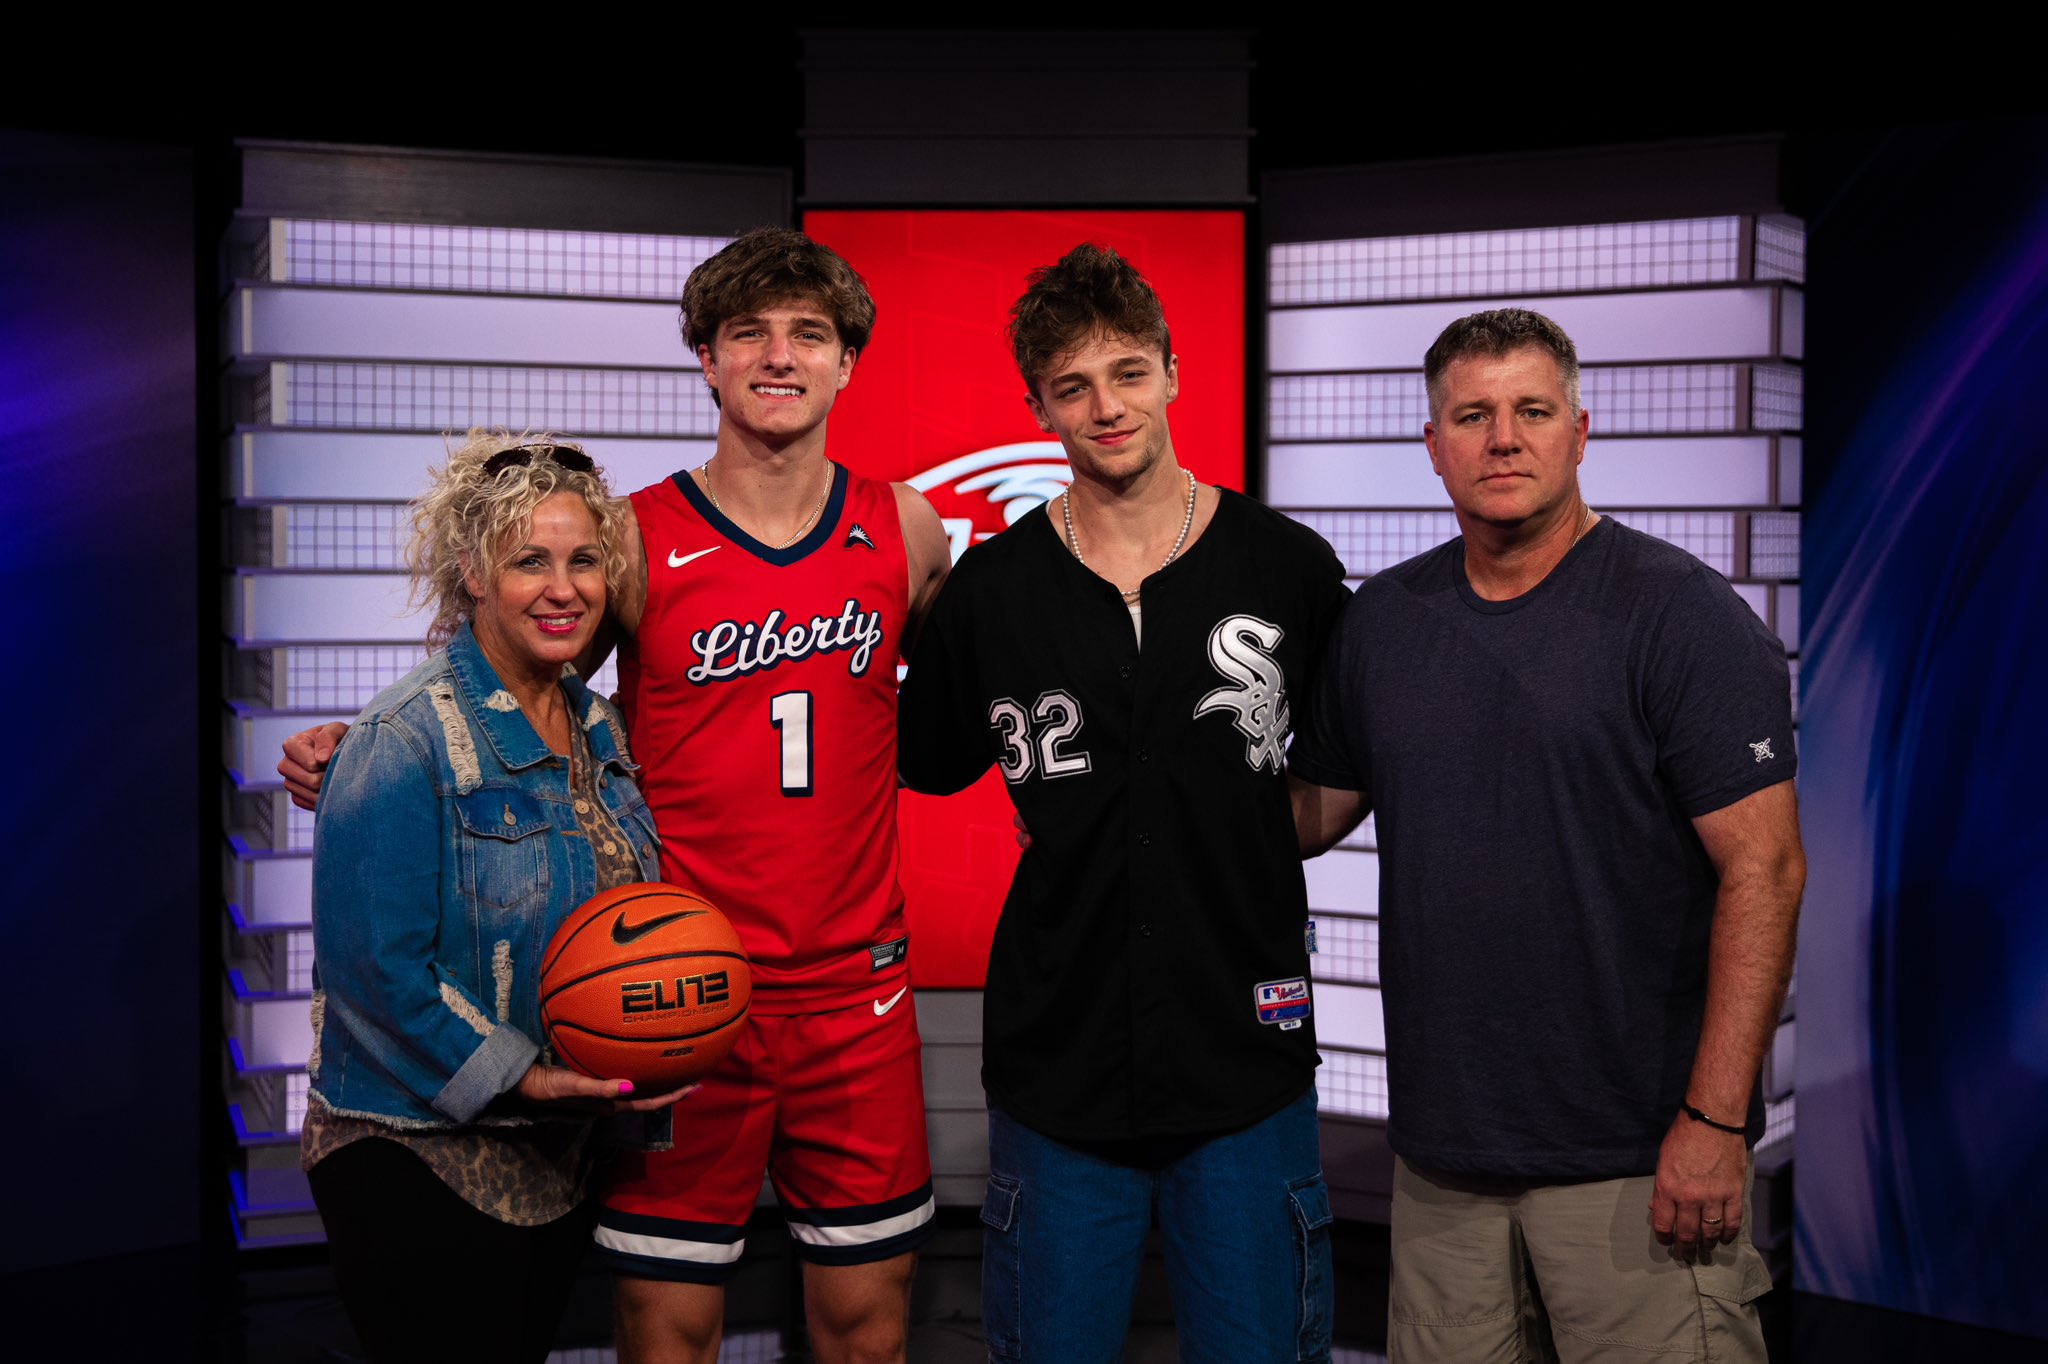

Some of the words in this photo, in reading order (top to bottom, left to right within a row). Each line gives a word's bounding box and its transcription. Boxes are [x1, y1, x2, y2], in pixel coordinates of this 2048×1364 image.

[687, 599, 882, 686] Liberty
[771, 691, 813, 797] 1
[988, 688, 1092, 784] 32
[621, 971, 729, 1014] ELITE
[622, 1002, 729, 1024] CHAMPIONSHIP
